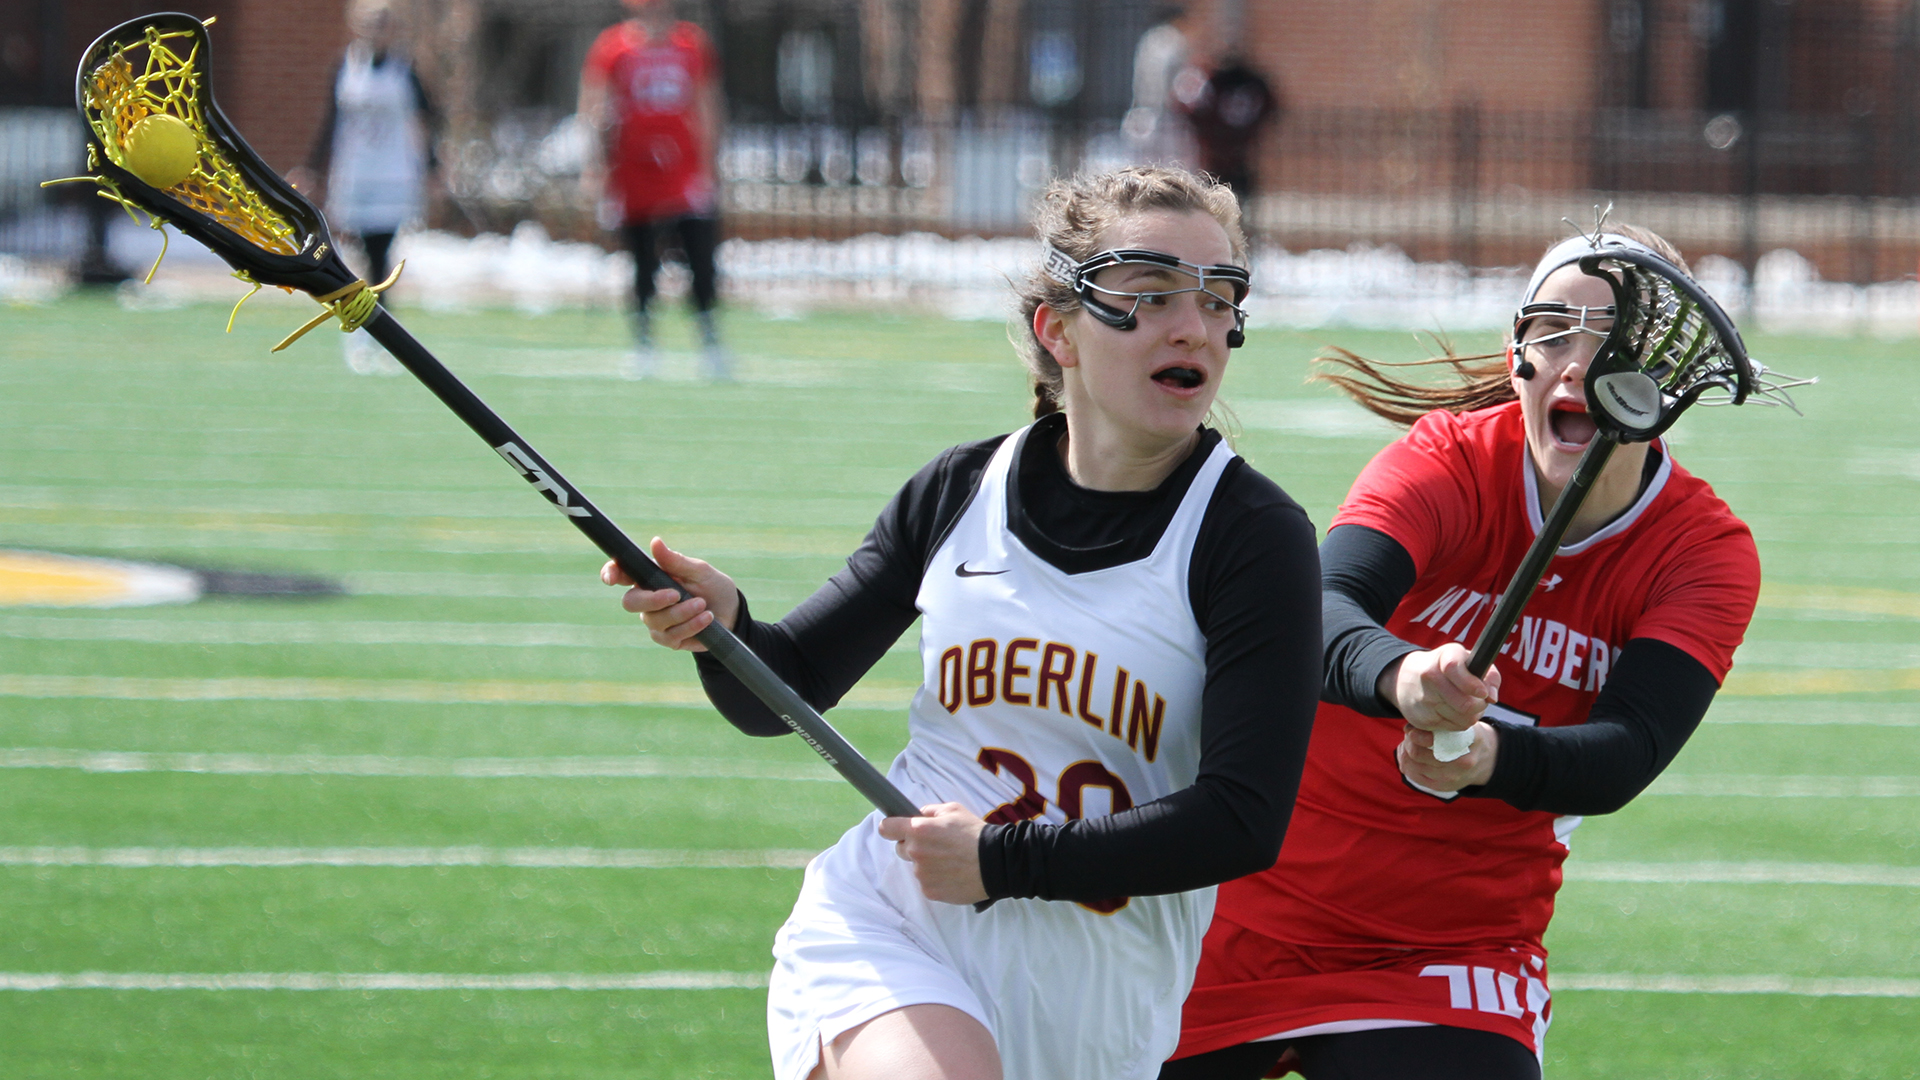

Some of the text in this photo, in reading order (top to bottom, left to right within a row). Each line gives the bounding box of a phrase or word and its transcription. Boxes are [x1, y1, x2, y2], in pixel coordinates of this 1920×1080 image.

[312, 242, 328, 260] STX
[494, 441, 592, 519] STX
[938, 637, 1166, 763] OBERLIN
[780, 714, 839, 766] COMPOSITE
